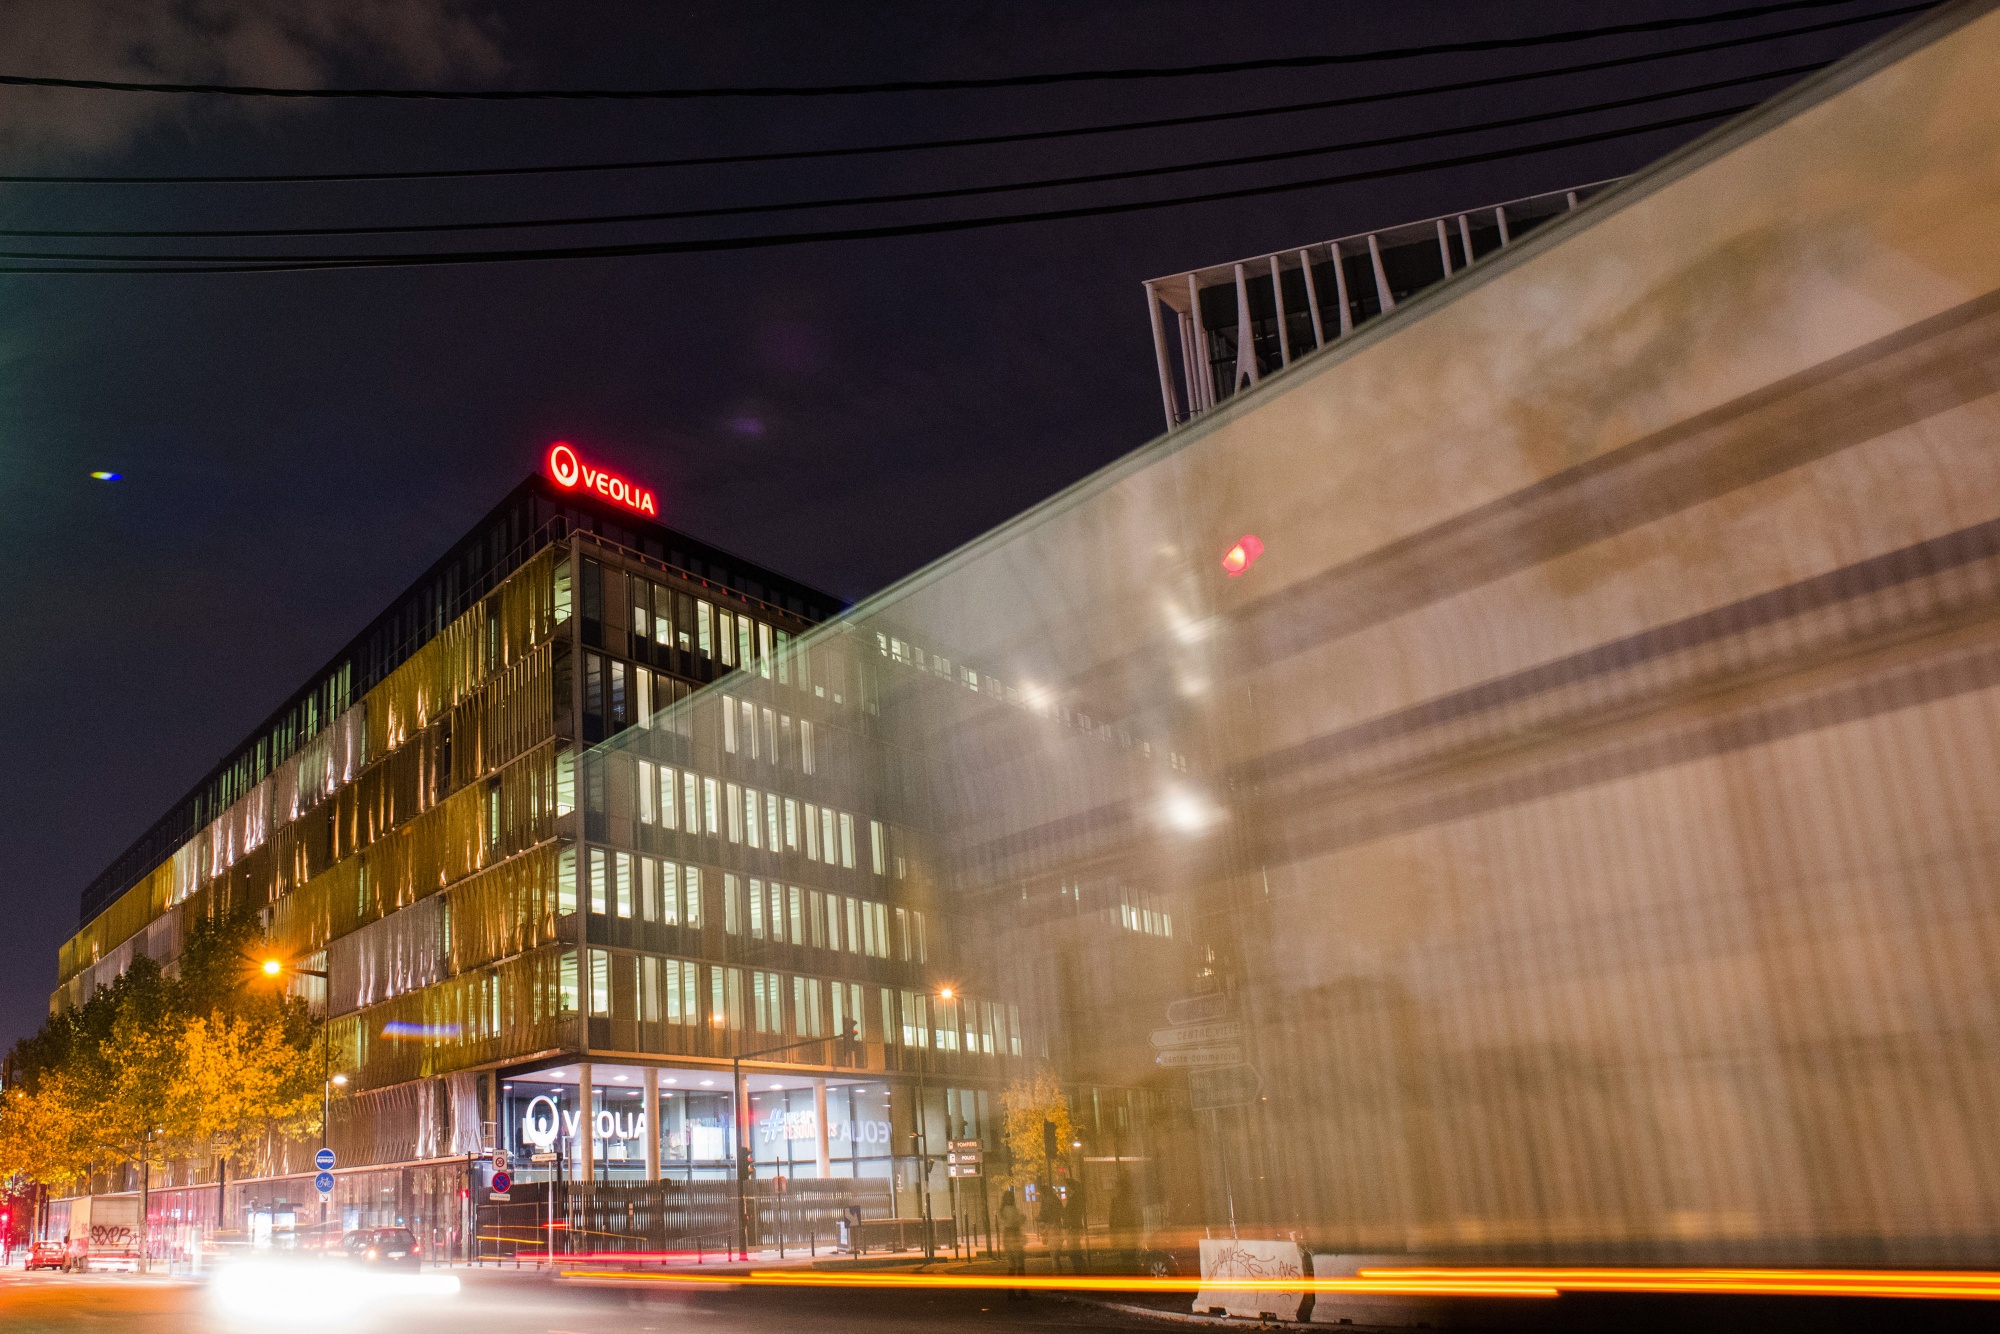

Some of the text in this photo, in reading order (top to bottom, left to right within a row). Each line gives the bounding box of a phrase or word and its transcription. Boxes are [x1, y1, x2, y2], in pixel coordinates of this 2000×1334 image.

[581, 464, 655, 515] VEOLIA
[1176, 1022, 1240, 1041] CENTRE VILLE
[562, 1110, 647, 1139] VOLIA
